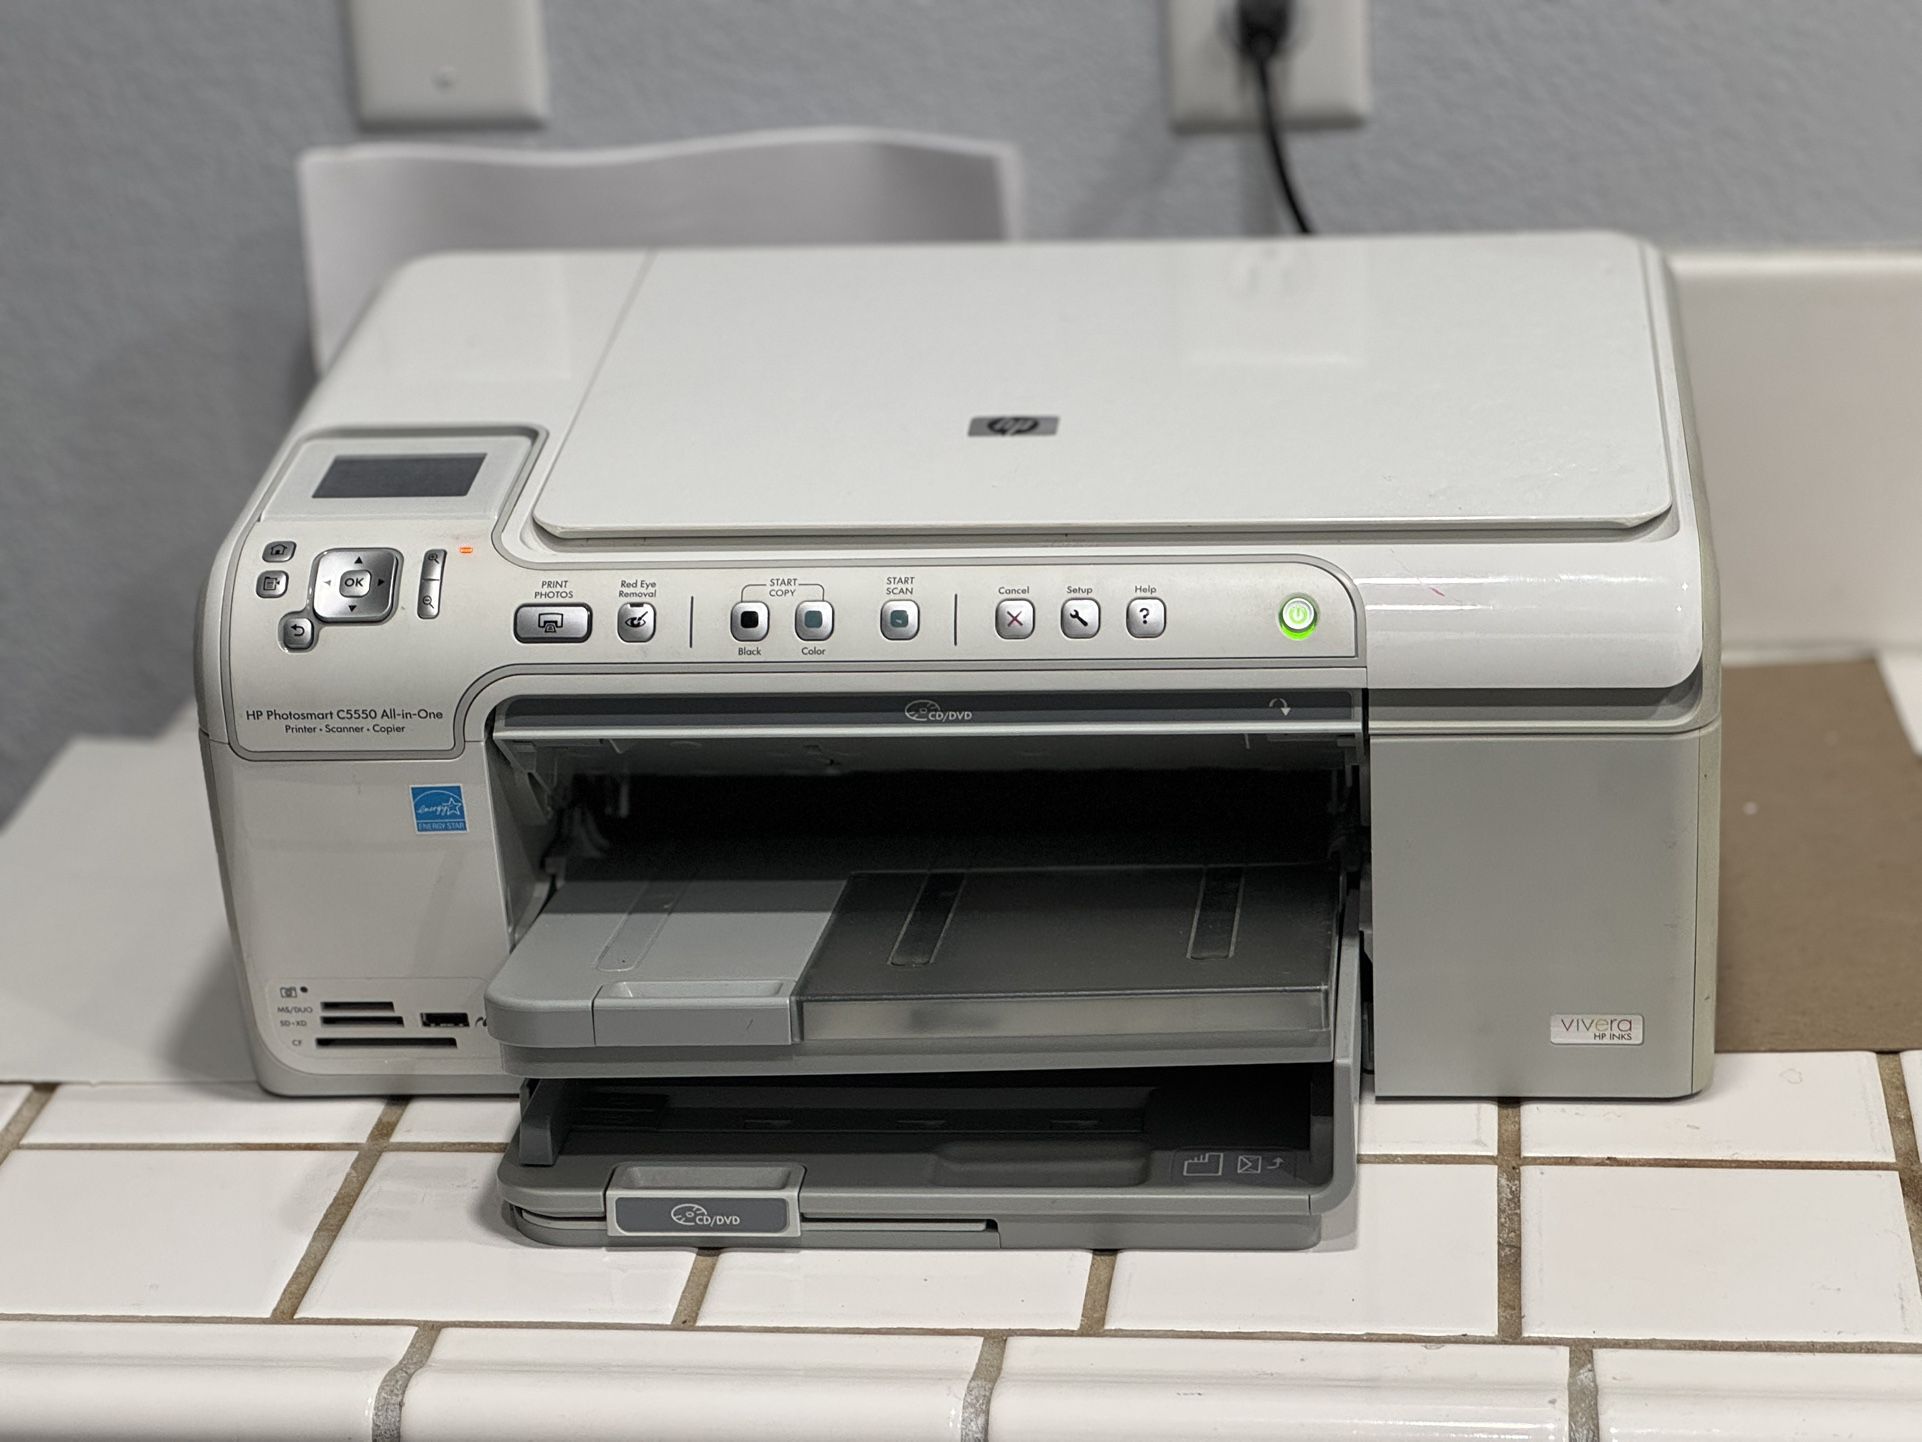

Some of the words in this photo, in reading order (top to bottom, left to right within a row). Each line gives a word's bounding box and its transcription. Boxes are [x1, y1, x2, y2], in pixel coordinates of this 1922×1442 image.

[344, 577, 364, 587] OK
[541, 580, 568, 589] PRINT
[620, 580, 638, 588] Red
[640, 580, 657, 590] Eye
[769, 578, 798, 587] START
[886, 576, 915, 585] START
[618, 590, 657, 598] Removal
[769, 589, 796, 597] COPY
[886, 587, 914, 595] SCAN
[998, 586, 1030, 595] Cancel
[1066, 586, 1093, 594] Setup
[1134, 585, 1157, 594] Help
[534, 590, 574, 599] PHOTOS
[738, 647, 762, 656] Black
[801, 647, 826, 656] Color
[246, 710, 263, 721] HP
[266, 710, 334, 720] Photosmart
[336, 709, 377, 720] C5550
[380, 708, 443, 720] All-in-One
[928, 711, 973, 722] CD/DVD
[284, 725, 317, 734] Printer
[325, 724, 365, 733] Scanner
[372, 724, 406, 735] Copier
[1561, 1018, 1632, 1032] vivera
[695, 1215, 740, 1227] CD/DVD
